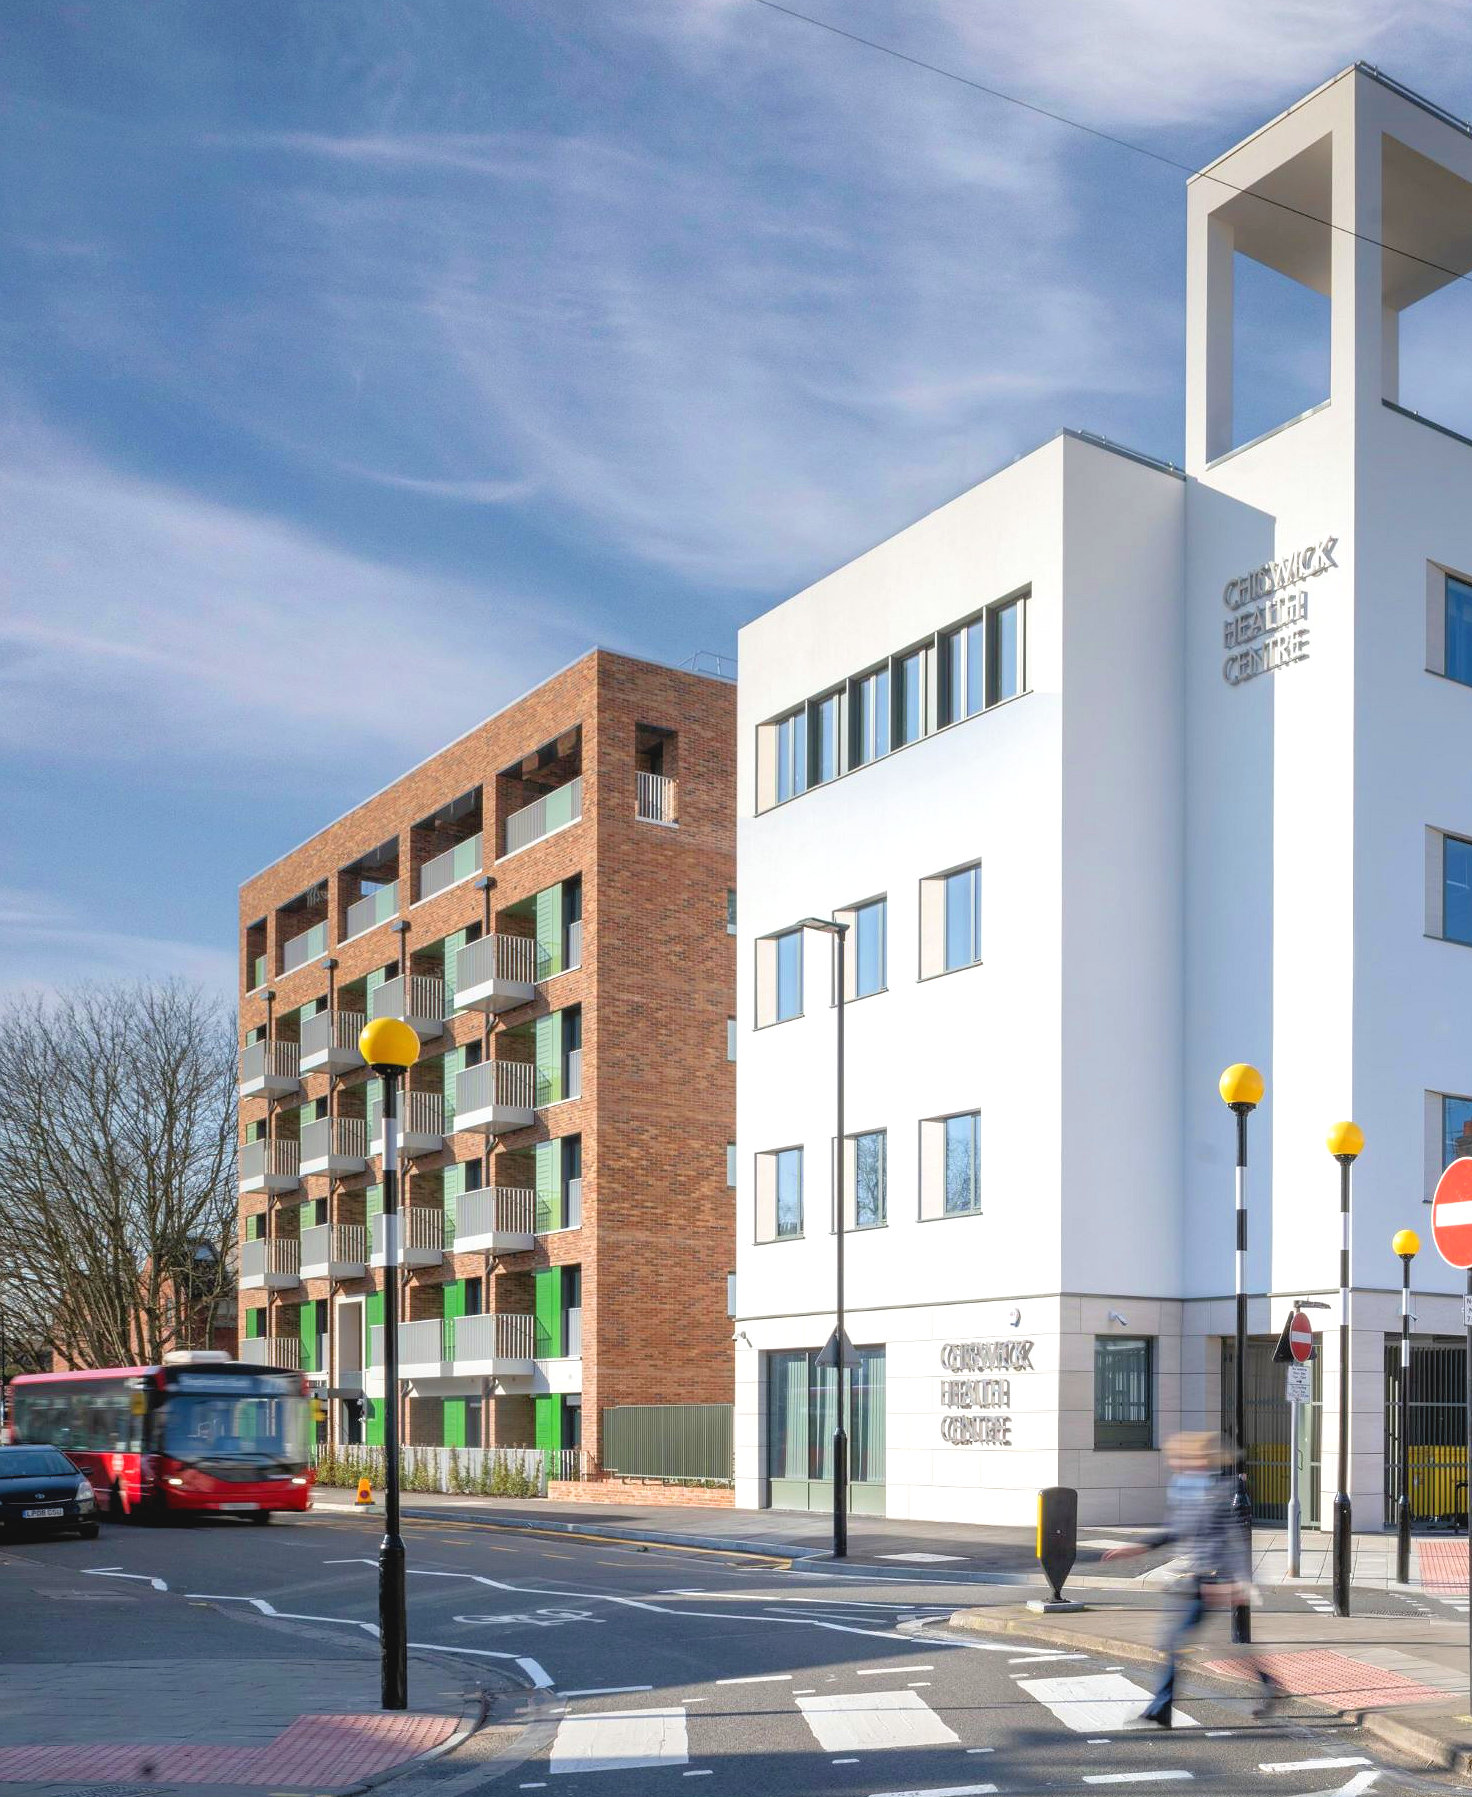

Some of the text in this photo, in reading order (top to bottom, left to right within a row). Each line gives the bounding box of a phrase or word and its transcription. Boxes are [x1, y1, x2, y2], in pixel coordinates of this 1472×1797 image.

[1223, 536, 1338, 611] CHISWICK
[1224, 591, 1308, 649] HEALTH
[1223, 629, 1309, 686] CENTRE
[941, 1340, 1034, 1373] CHISWICK
[941, 1379, 1010, 1409] HEALTH
[941, 1415, 1012, 1446] CENTRE
